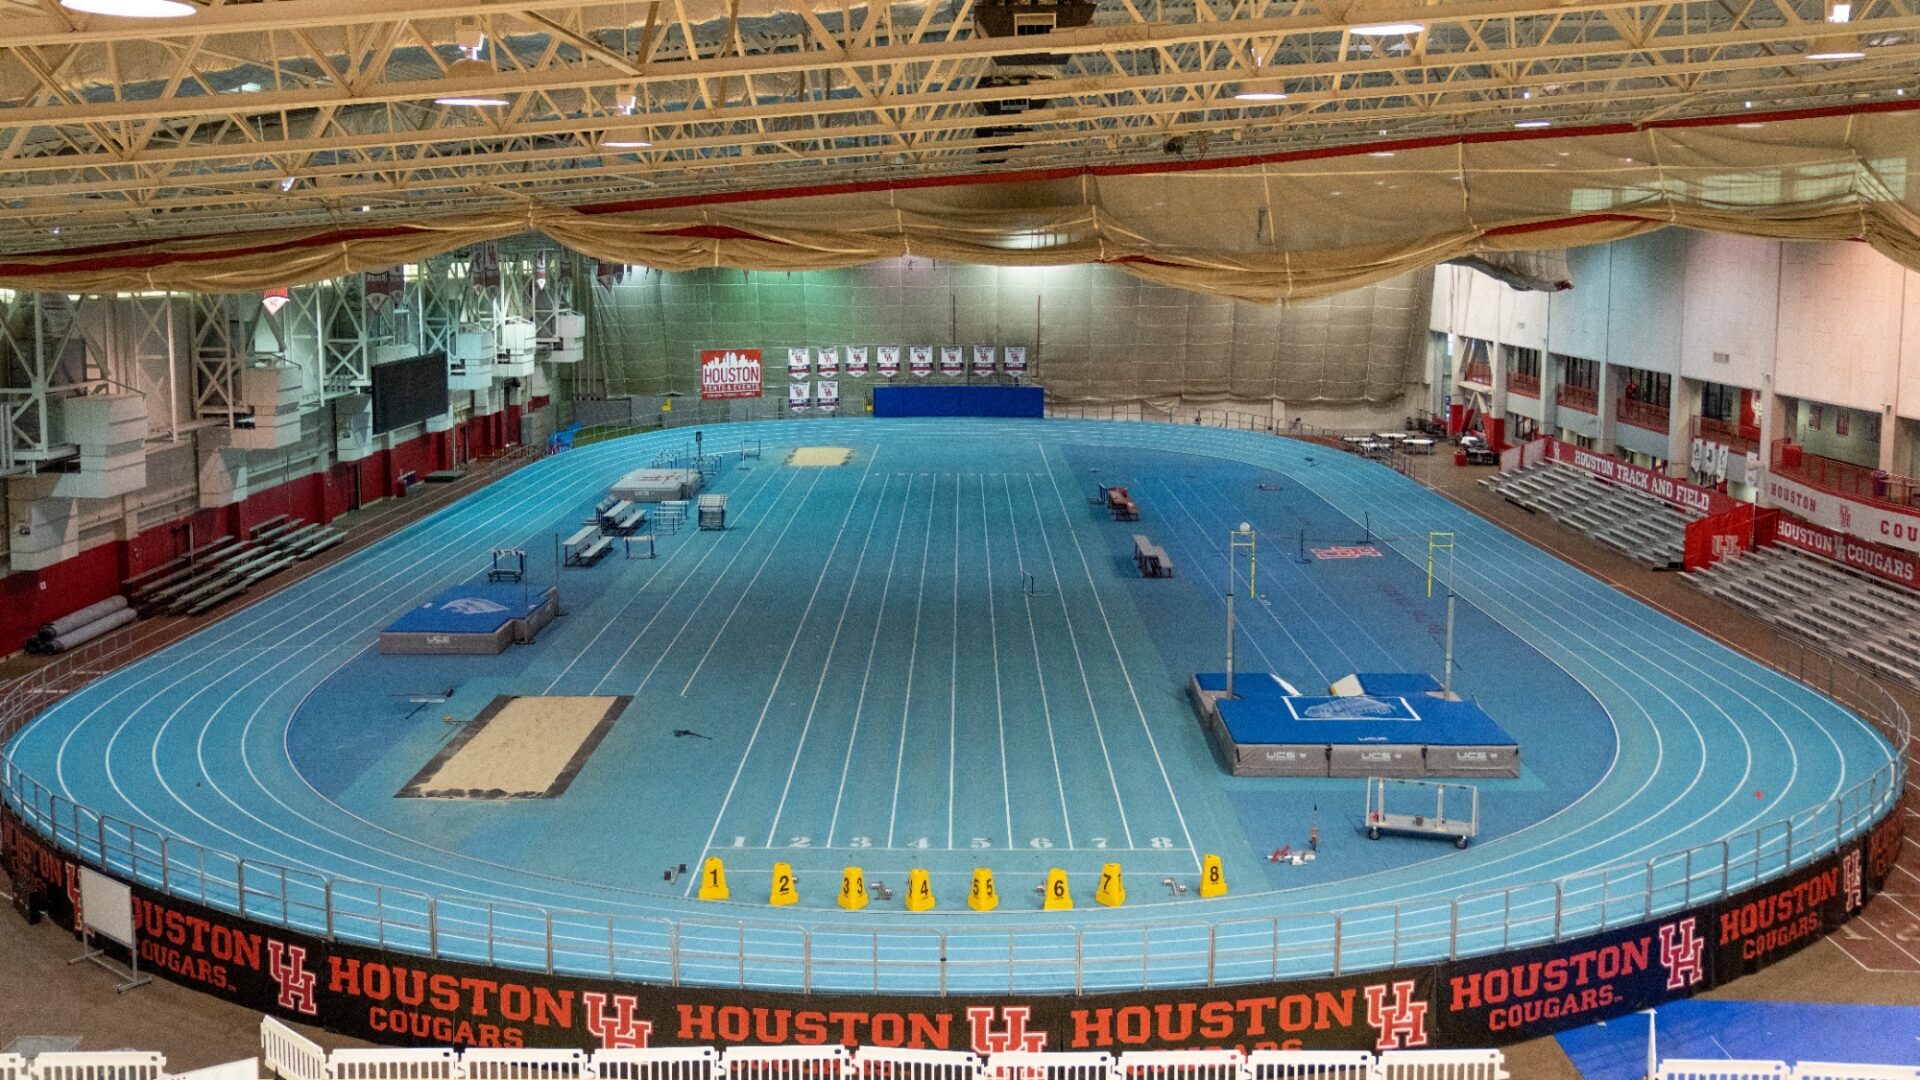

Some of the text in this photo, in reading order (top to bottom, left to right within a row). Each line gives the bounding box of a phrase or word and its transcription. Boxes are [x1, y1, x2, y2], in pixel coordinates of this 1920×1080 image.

[704, 367, 759, 383] HOUSTON
[1575, 450, 1613, 477] HOUSTON
[1617, 464, 1649, 489] TRACK
[1652, 481, 1673, 500] AND
[1677, 485, 1709, 511] FIELD
[1771, 483, 1816, 512] HOUSTON
[1778, 519, 1832, 552] HOUSTON
[1848, 544, 1914, 581] COUGARS
[1266, 752, 1296, 761] UCS
[1361, 752, 1391, 761] UCS
[1457, 752, 1487, 760] UCS
[788, 837, 811, 848] 2
[851, 837, 872, 848] 3
[907, 837, 928, 849] 4
[970, 838, 992, 849] 5
[1030, 838, 1053, 849] 6
[1091, 838, 1108, 849] 7
[1151, 837, 1174, 849] 8
[709, 869, 718, 885] 1
[778, 875, 789, 892] 2
[843, 877, 863, 894] 3 3
[1103, 873, 1112, 891] 7
[1210, 865, 1219, 883] 8
[920, 880, 928, 896] 4
[973, 879, 993, 896] 5 5
[1053, 880, 1065, 897] 6
[1720, 867, 1838, 945] HOUSTON
[1743, 912, 1818, 960] COUGARS
[131, 896, 262, 971] OUSTON
[267, 939, 317, 1015] UH
[135, 939, 227, 988] OUGARS
[1450, 917, 1704, 1012] HOUSTON UH
[328, 956, 574, 1028] HOUSTON
[1071, 980, 1428, 1049] HOUSTON UH
[1488, 985, 1613, 1031] COUGARS
[370, 1006, 523, 1048] COUGARS
[676, 1004, 953, 1049] HOUSTON
